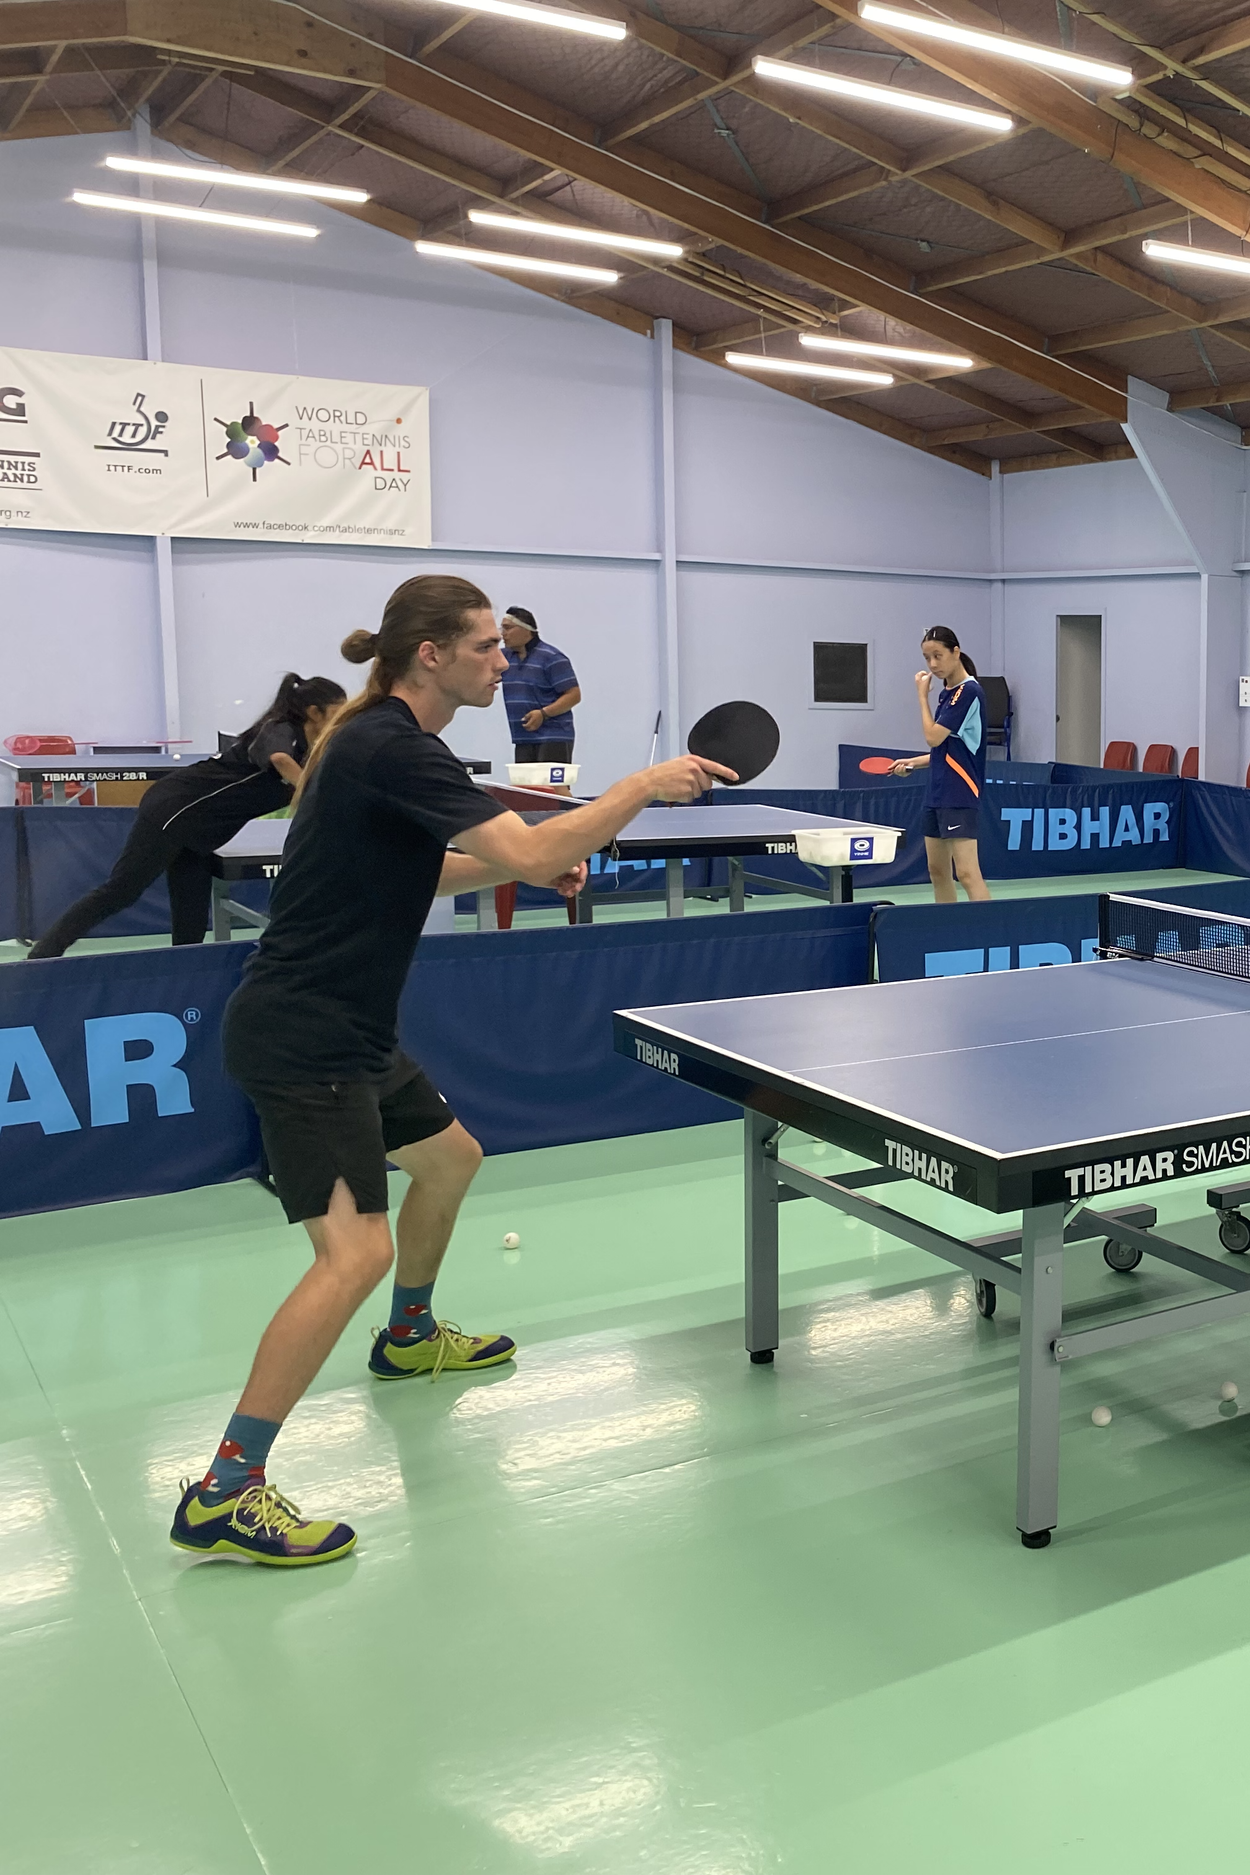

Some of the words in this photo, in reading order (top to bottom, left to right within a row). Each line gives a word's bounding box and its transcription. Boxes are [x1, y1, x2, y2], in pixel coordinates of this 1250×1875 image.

[295, 405, 368, 426] WORLD
[295, 427, 411, 449] TABLETENNIS
[106, 464, 162, 475] ITTF.com
[374, 476, 411, 492] DAY
[233, 520, 407, 536] www.facebook.com/tabletennisnz
[42, 773, 85, 781] TIBHAR
[1001, 802, 1171, 851] TIBHAR
[765, 842, 798, 855] TIBH
[262, 864, 282, 878] TI
[635, 1037, 679, 1076] TIBHAR
[885, 1138, 954, 1192] TIBHAR
[1065, 1151, 1175, 1196] TIBHAR
